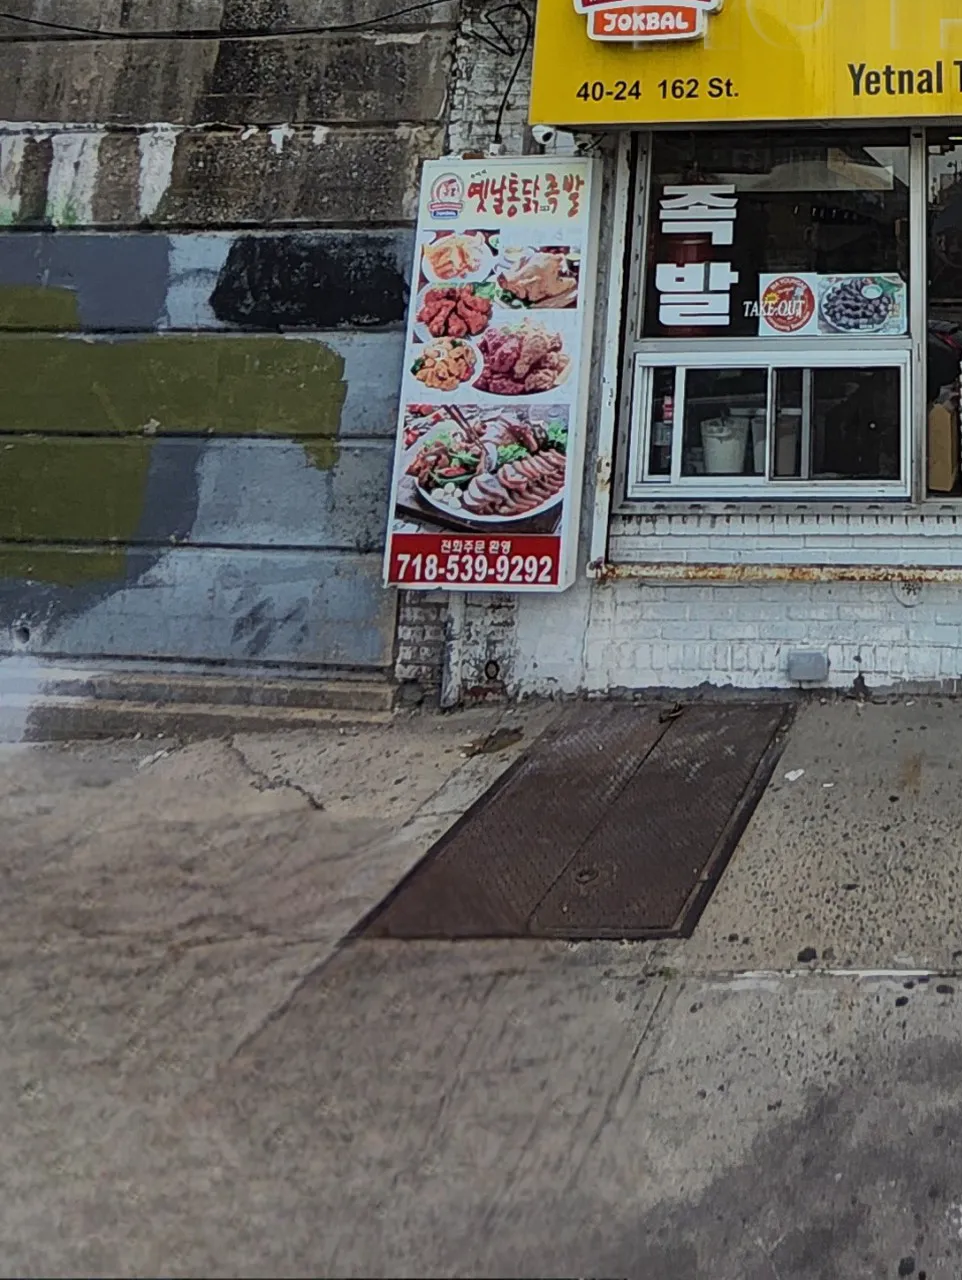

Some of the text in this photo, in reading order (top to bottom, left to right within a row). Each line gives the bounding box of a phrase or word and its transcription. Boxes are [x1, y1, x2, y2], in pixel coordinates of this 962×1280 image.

[603, 11, 689, 32] JOKBAL
[576, 77, 739, 102] 40-24 162 St.
[847, 61, 943, 96] Yetnal
[655, 184, 739, 326] 족발
[396, 552, 553, 583] 718-539-9292
